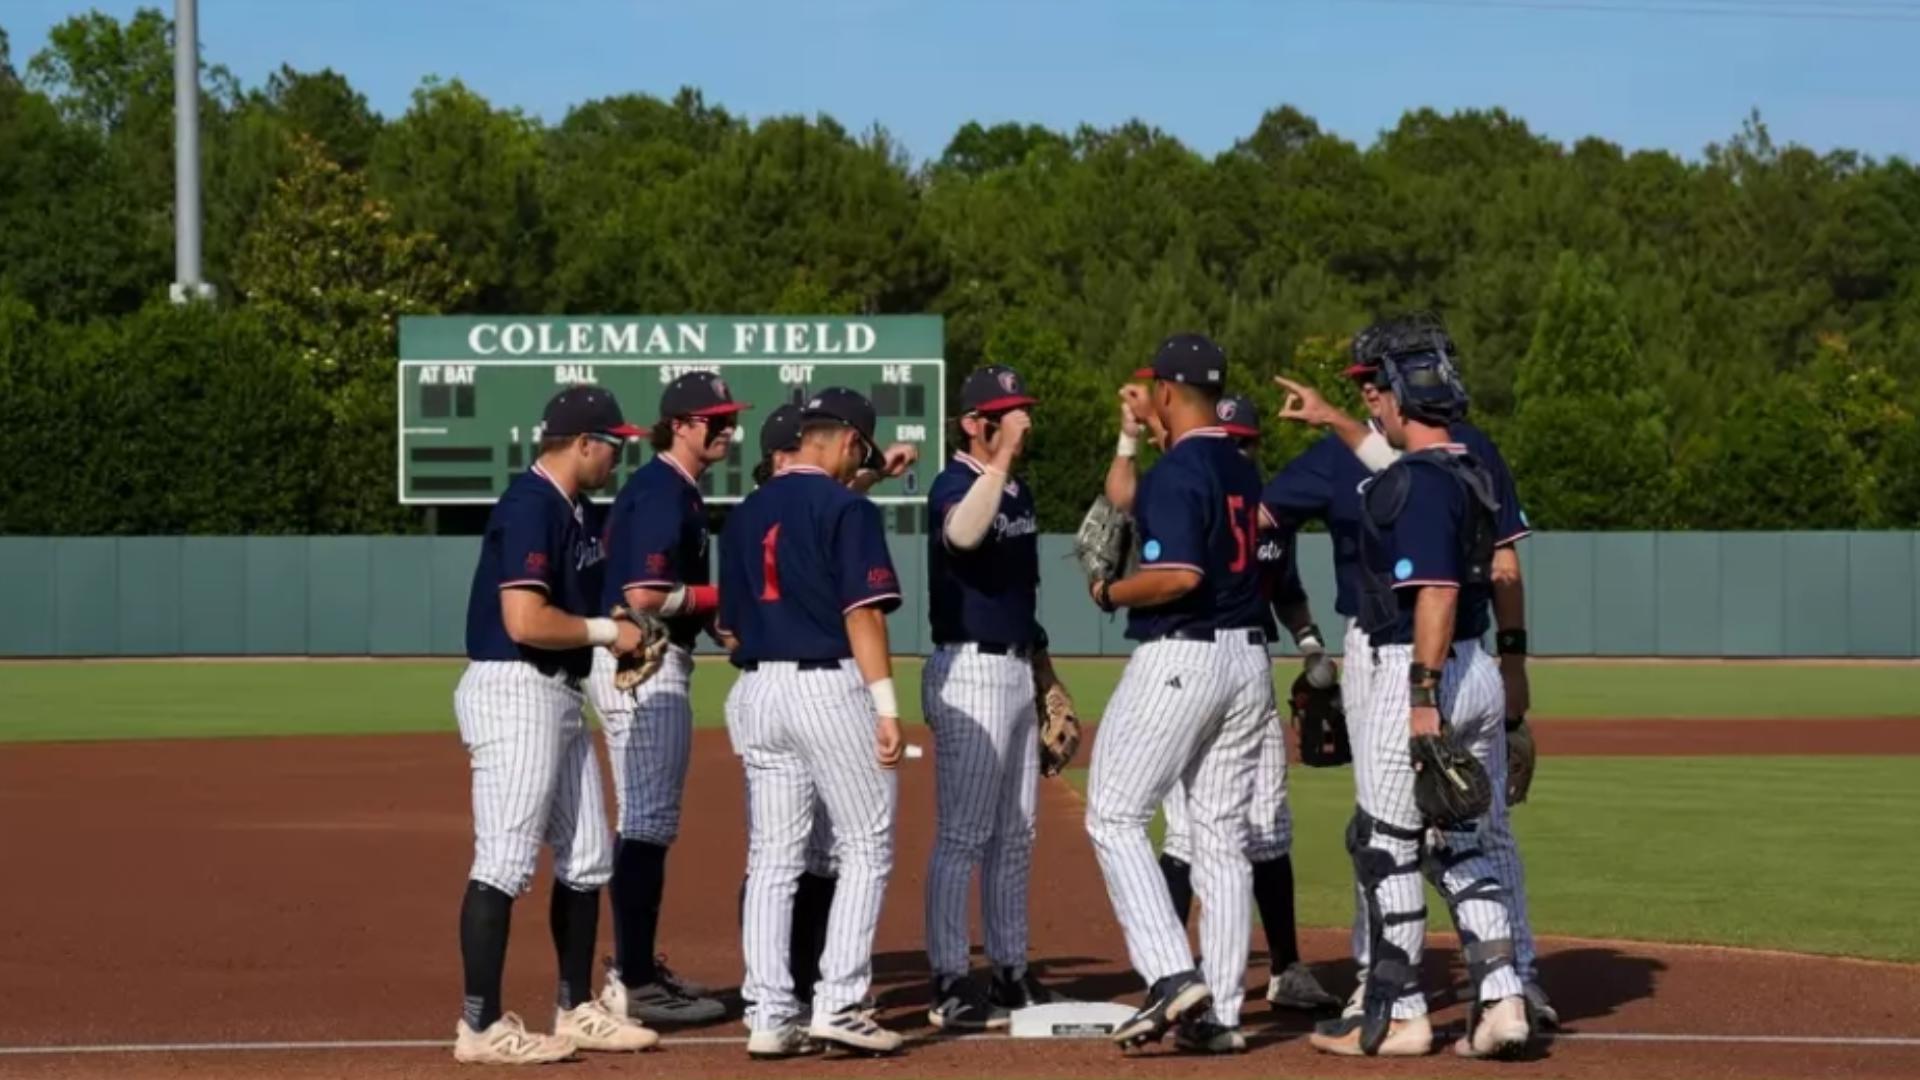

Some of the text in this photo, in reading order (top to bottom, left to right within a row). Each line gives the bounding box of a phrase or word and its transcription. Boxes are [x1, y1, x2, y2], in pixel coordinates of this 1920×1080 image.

[468, 323, 877, 355] COLEMAN FIELD
[419, 366, 477, 384] AT BAT
[555, 366, 597, 384] BALL
[780, 366, 814, 383] OUT
[882, 365, 912, 384] H/E
[511, 426, 519, 442] 1
[896, 425, 926, 441] ERR
[760, 522, 782, 603] 1
